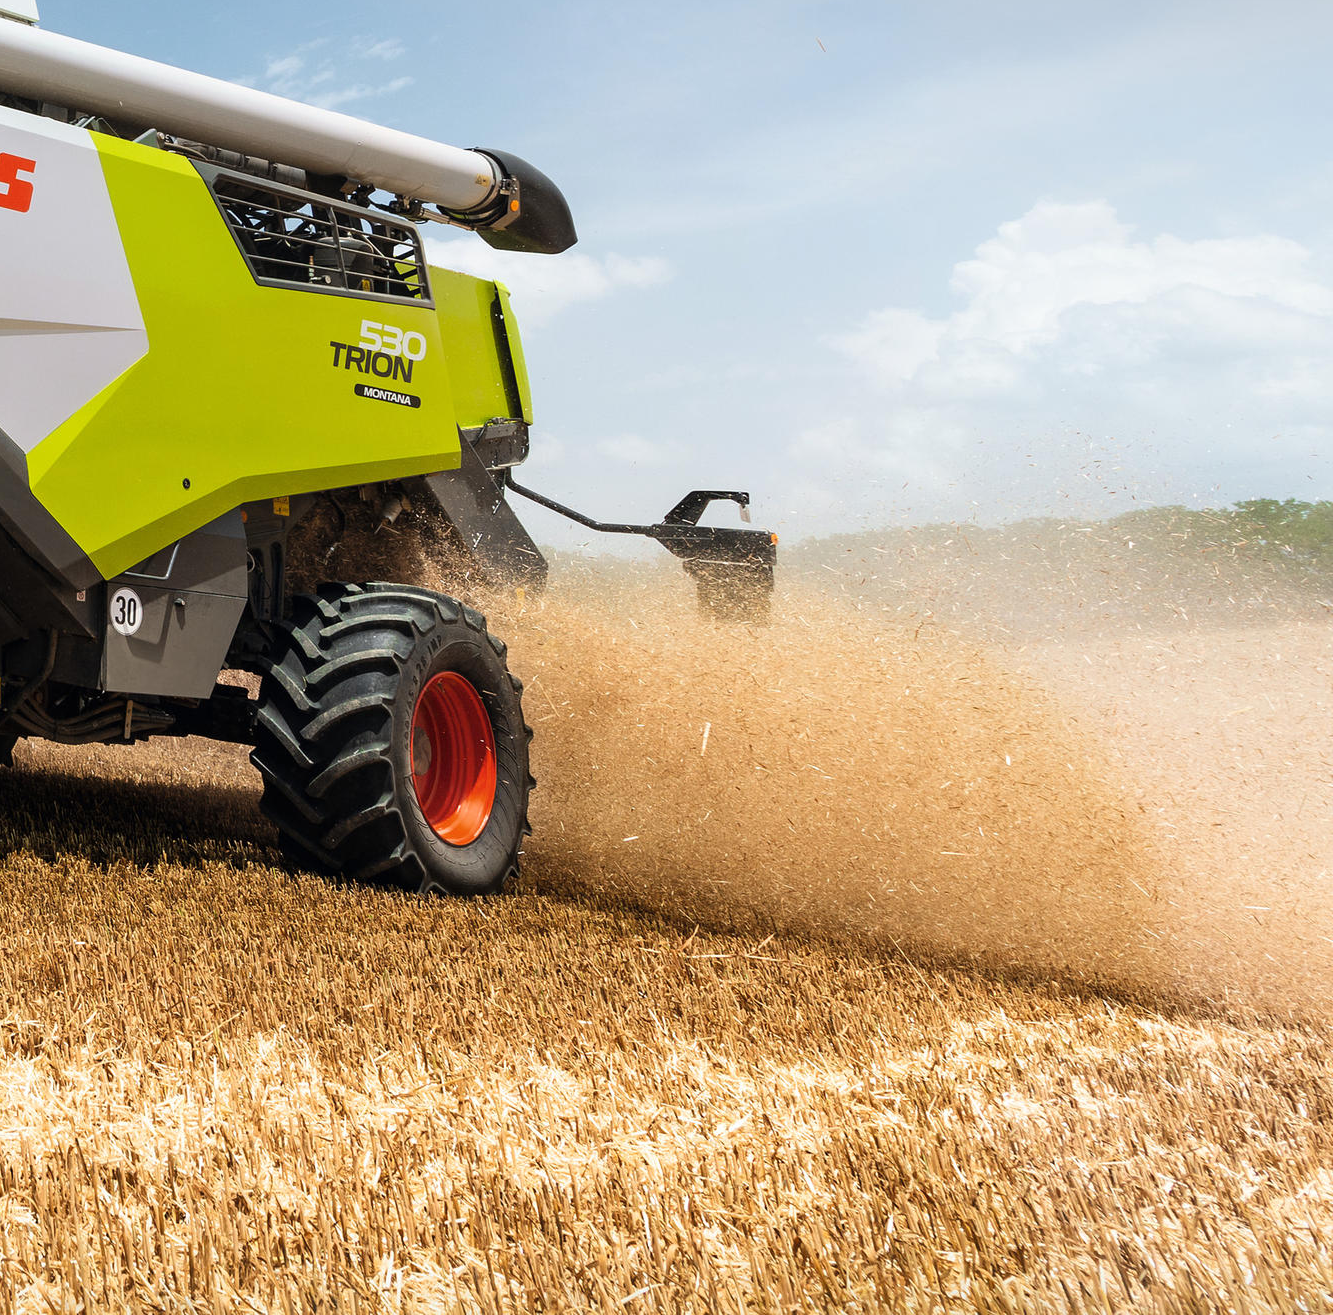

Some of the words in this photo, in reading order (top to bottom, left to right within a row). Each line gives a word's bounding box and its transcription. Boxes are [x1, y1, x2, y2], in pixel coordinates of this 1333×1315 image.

[359, 319, 426, 361] 530
[330, 341, 413, 383] TRION
[364, 387, 411, 405] MONTANA
[115, 596, 136, 626] 30
